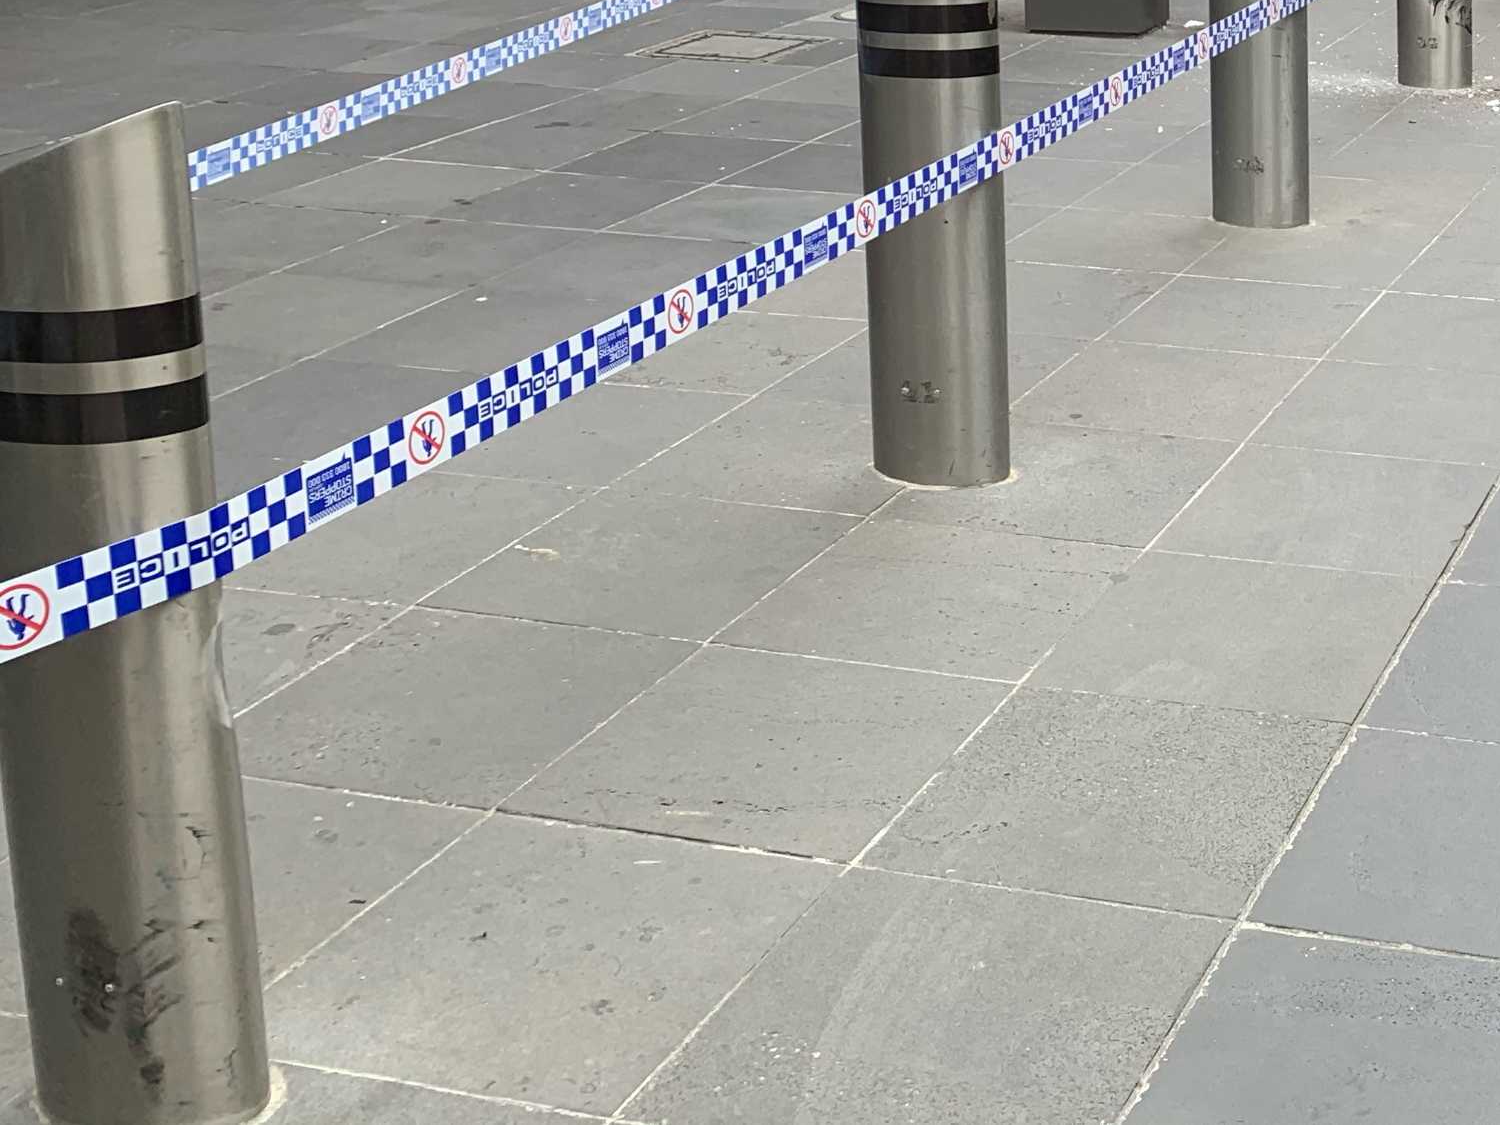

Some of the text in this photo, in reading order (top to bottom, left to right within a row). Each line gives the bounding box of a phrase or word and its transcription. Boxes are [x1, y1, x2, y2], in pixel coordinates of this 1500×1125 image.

[1027, 114, 1063, 142] POLICE
[893, 178, 938, 210] POLICE
[719, 257, 776, 298] POLICE
[480, 366, 558, 418] POLICE
[309, 475, 353, 503] STOPPERS
[324, 486, 353, 507] CRIME
[114, 518, 250, 590] POLICE
